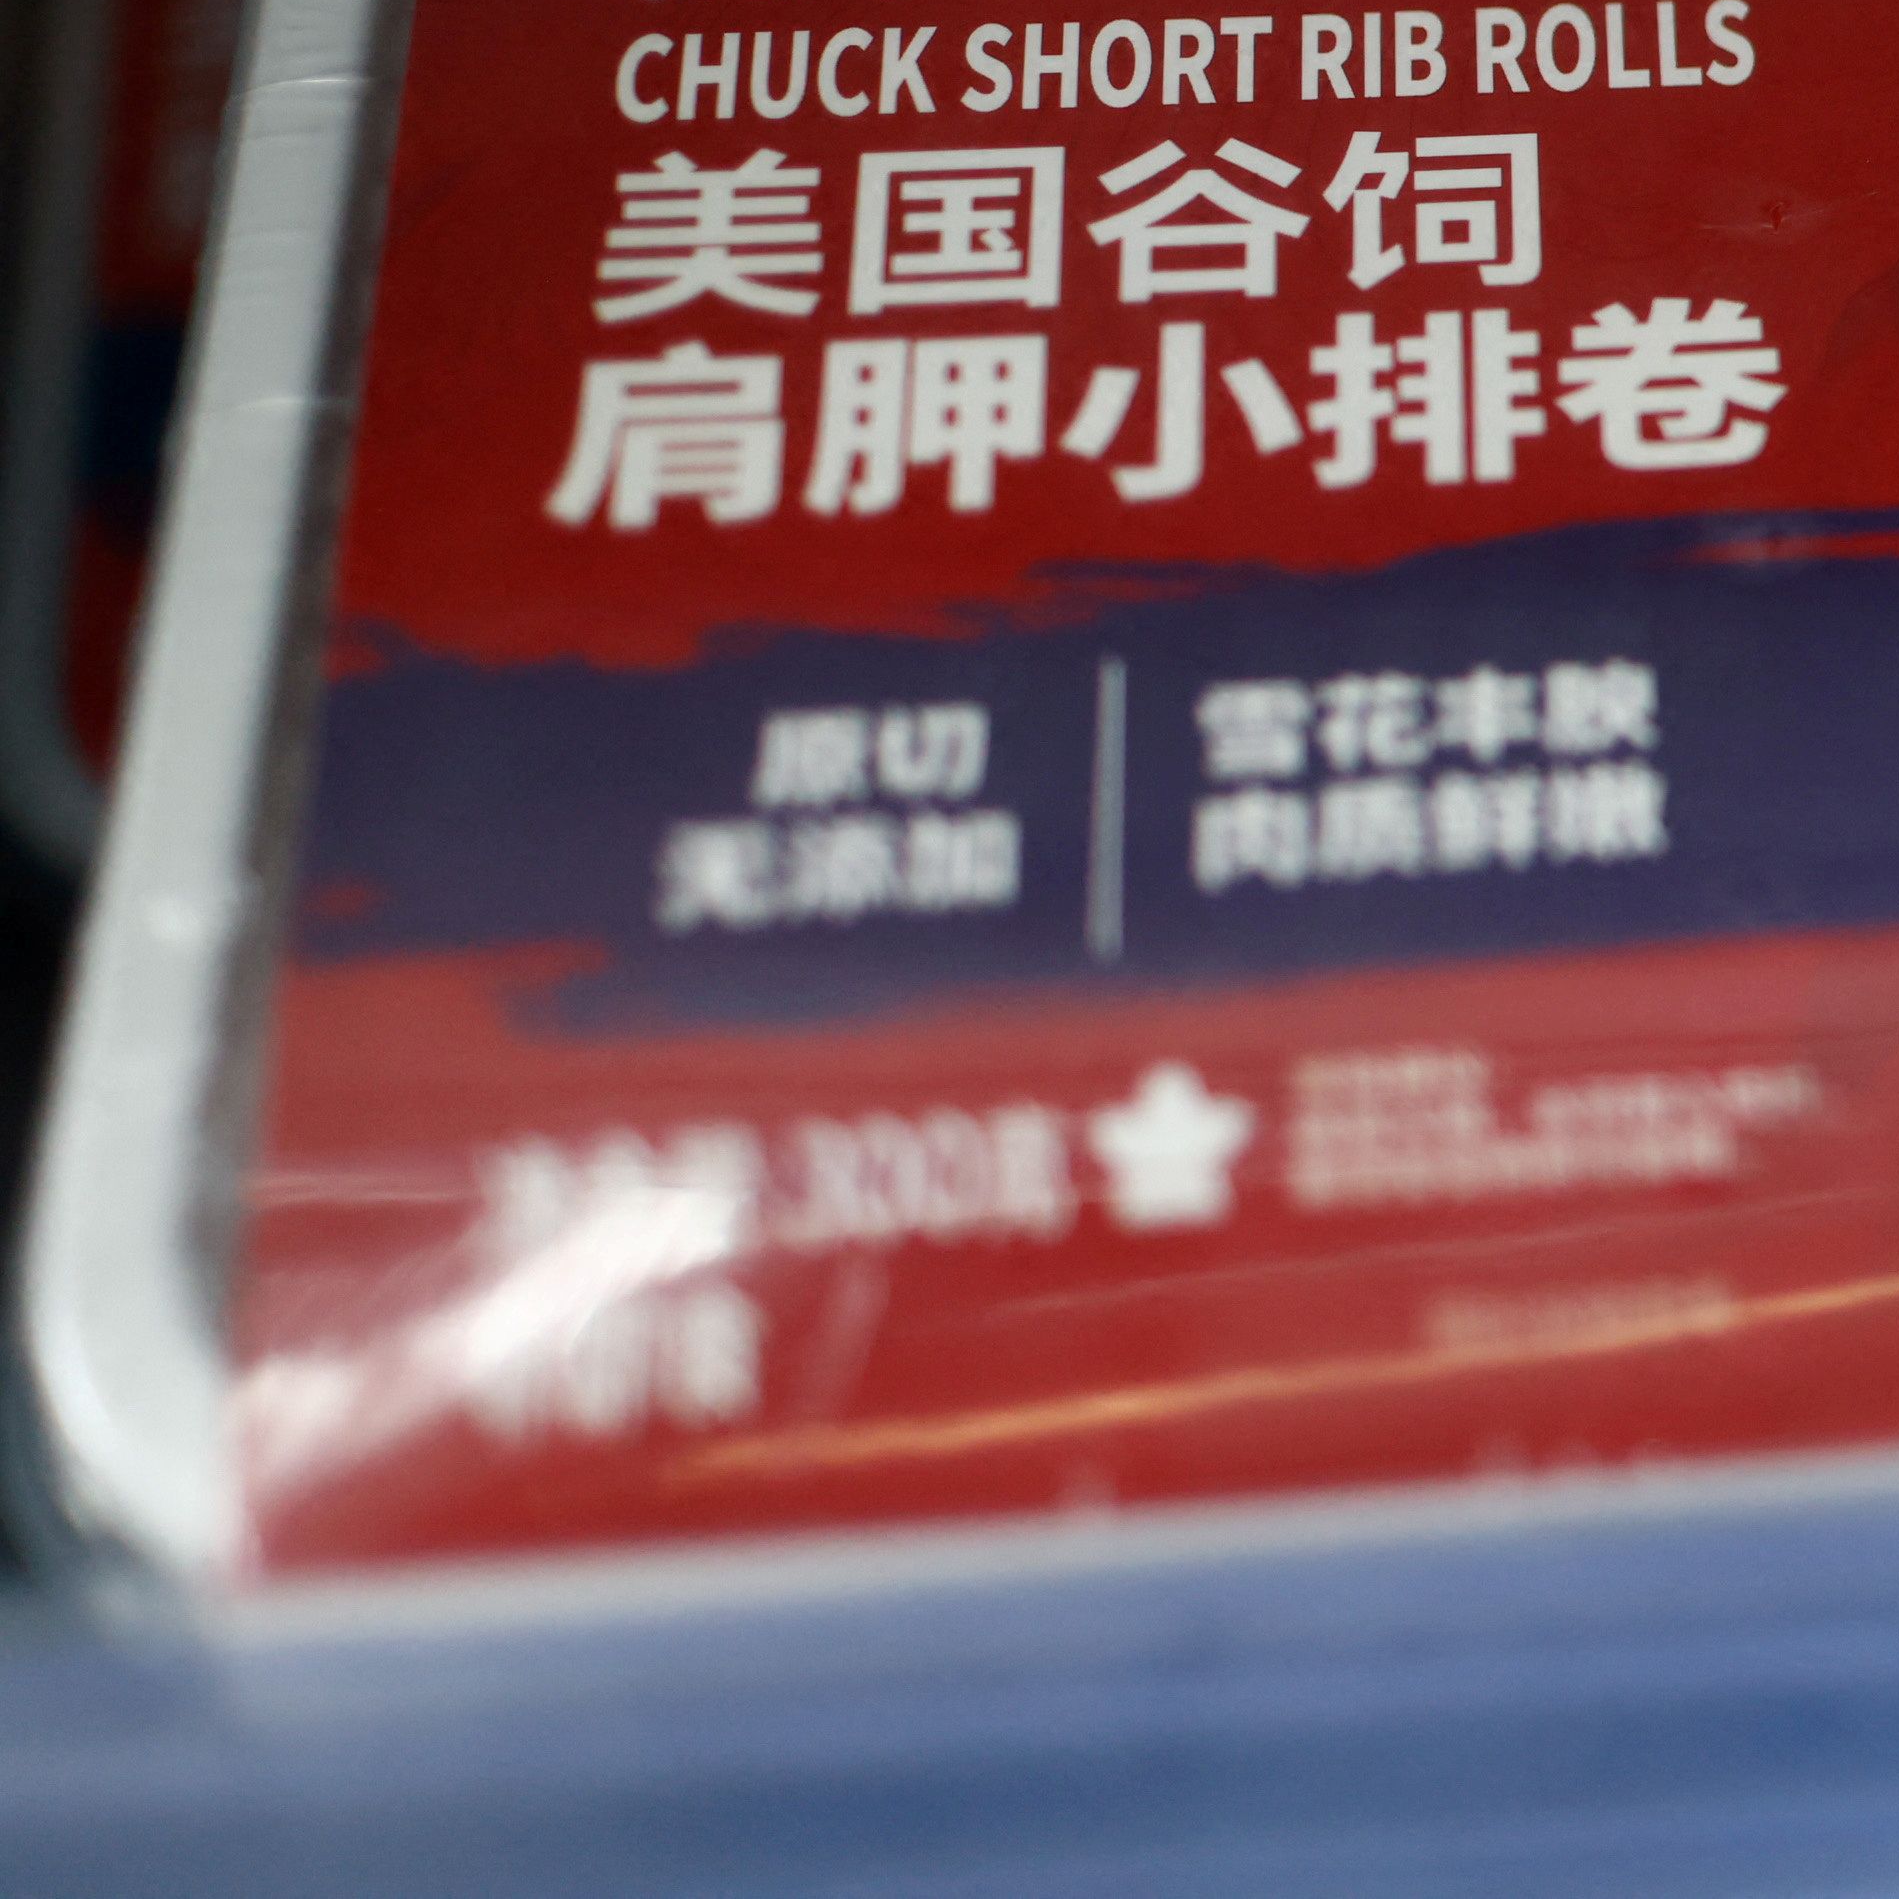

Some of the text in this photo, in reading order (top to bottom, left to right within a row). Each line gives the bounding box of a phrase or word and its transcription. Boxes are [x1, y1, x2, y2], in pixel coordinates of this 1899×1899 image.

[615, 25, 939, 124] CHUCK
[960, 14, 1274, 113] SHORT
[1300, 9, 1448, 101] RIB
[594, 130, 1543, 323] 美国谷饲
[548, 296, 1787, 529] 肩胛小排卷
[753, 704, 988, 808] 原切
